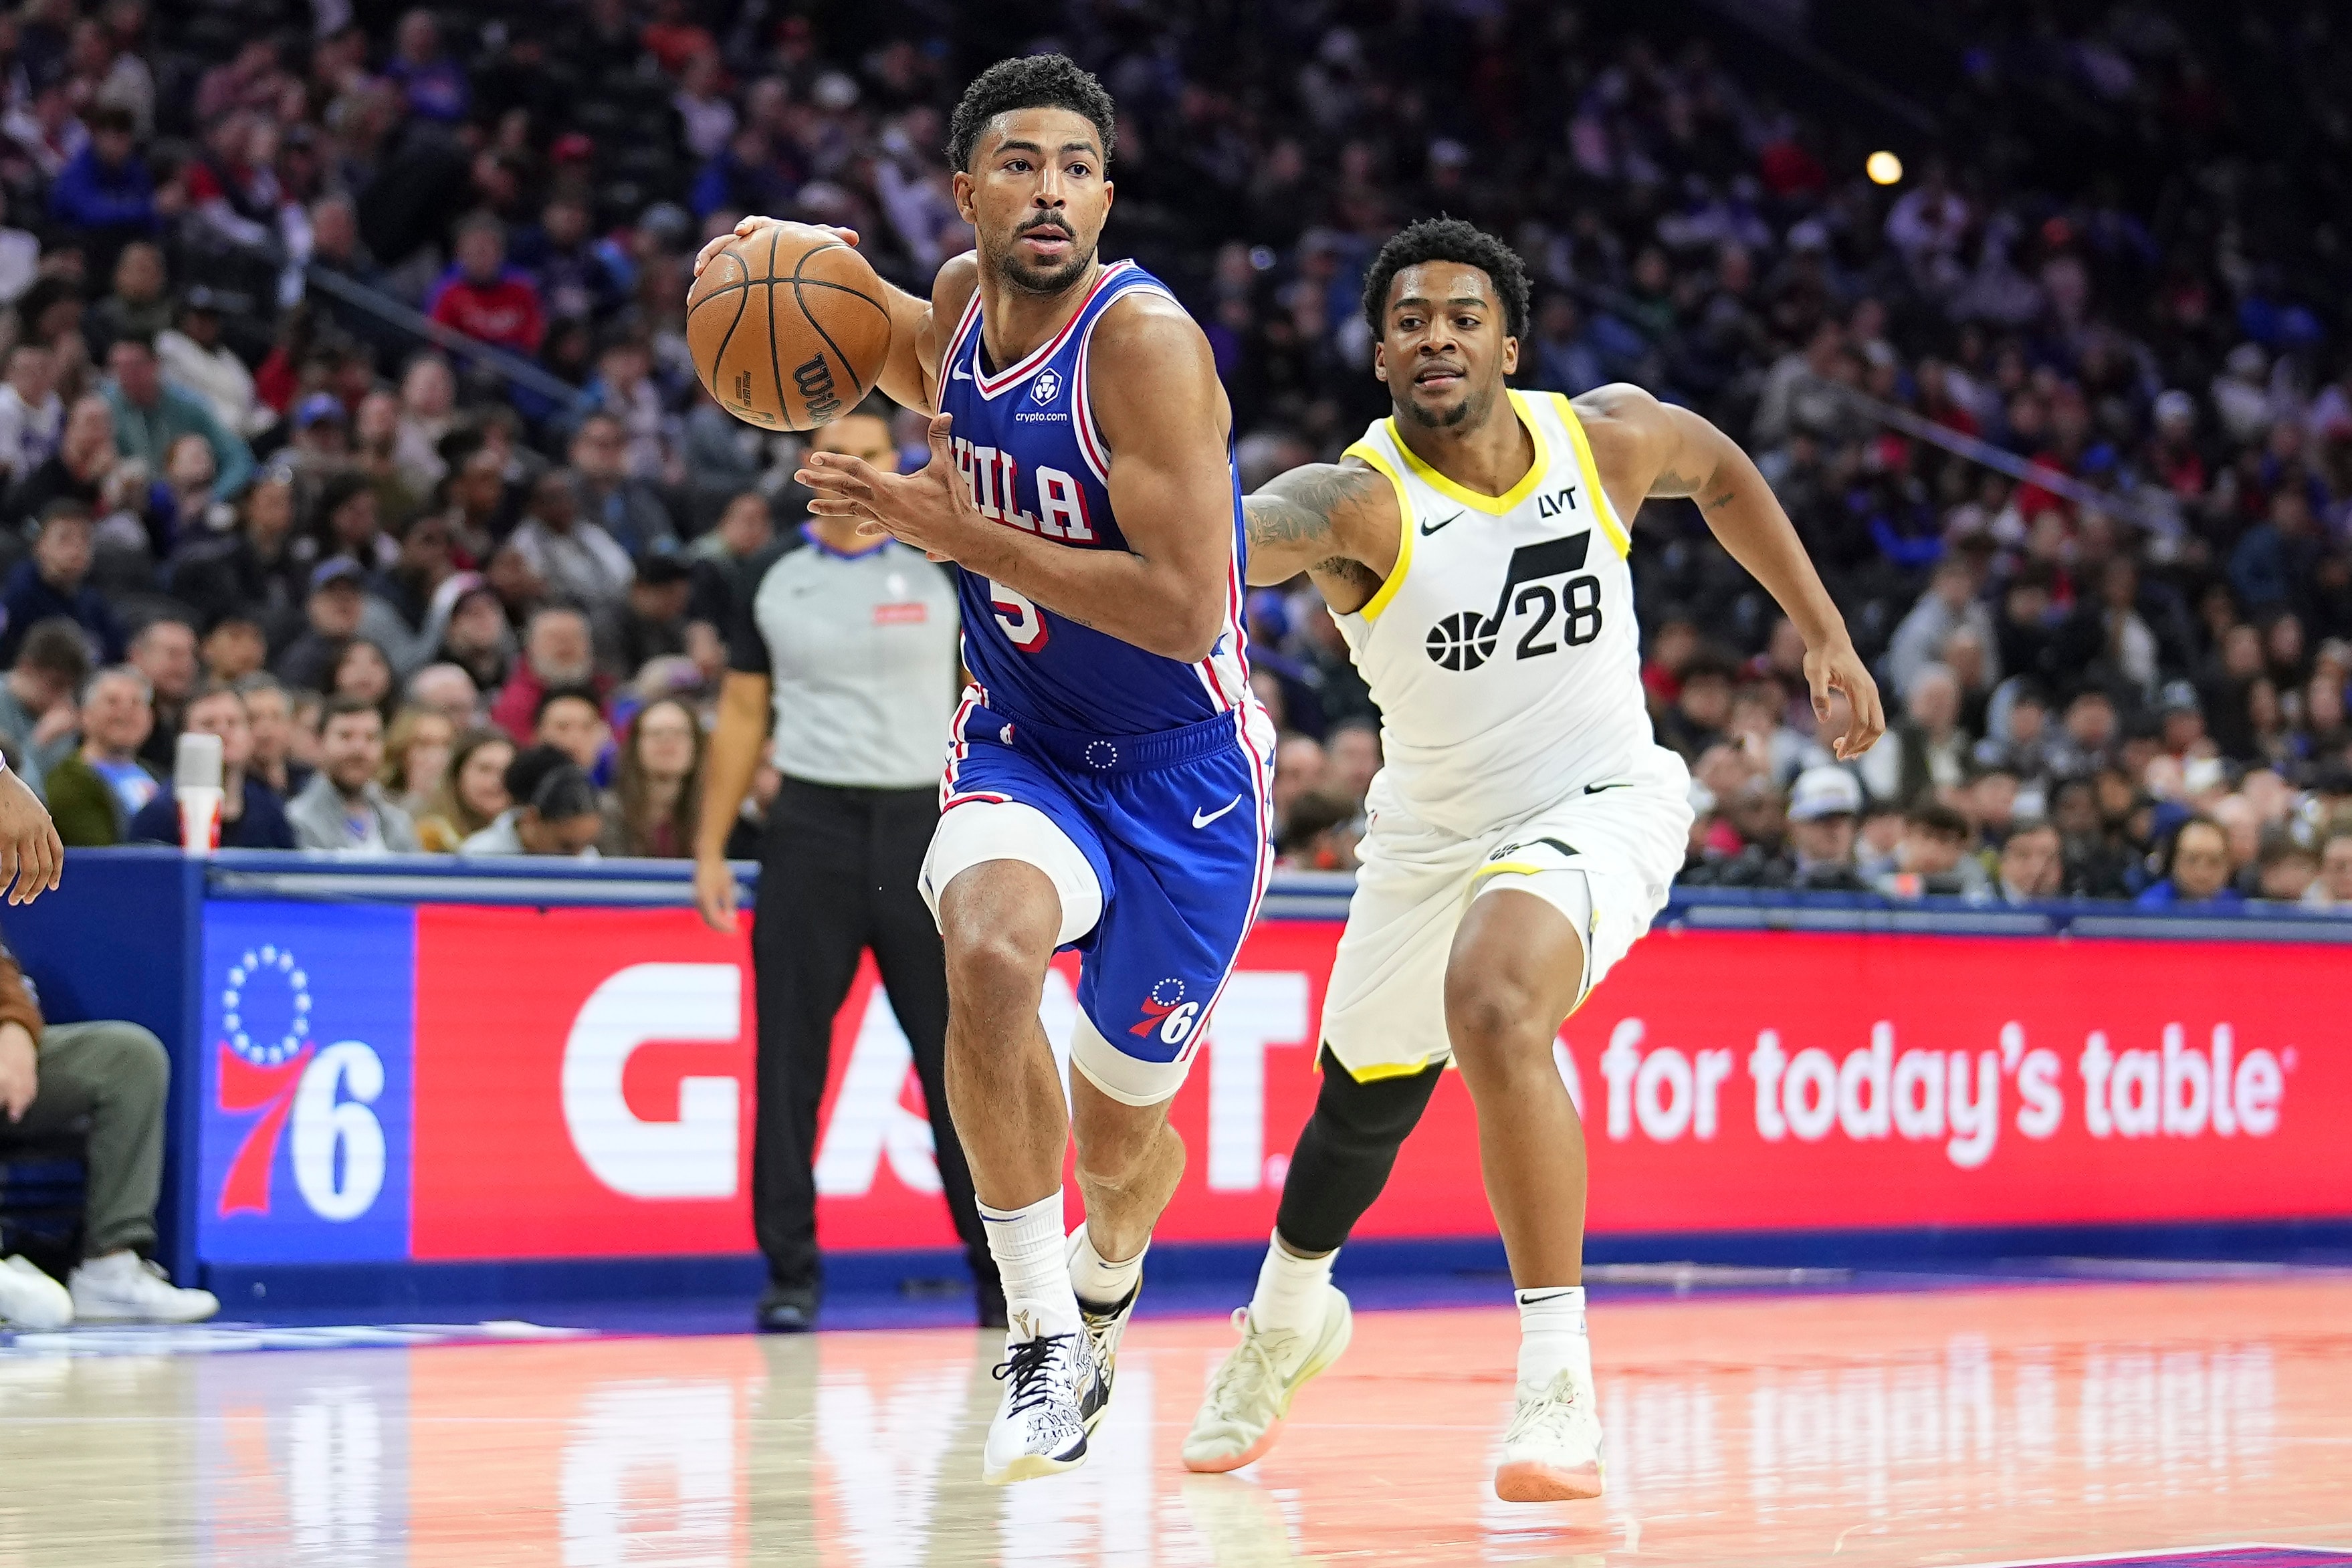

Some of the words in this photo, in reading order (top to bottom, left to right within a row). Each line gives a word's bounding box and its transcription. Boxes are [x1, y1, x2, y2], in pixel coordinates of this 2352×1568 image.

[1015, 412, 1067, 423] crypto.com
[948, 435, 1099, 544] HILA
[1537, 485, 1576, 519] LVT
[989, 578, 1049, 653] 5
[1515, 574, 1602, 661] 28
[1128, 996, 1199, 1044] 76
[217, 1039, 388, 1224] 76
[1600, 1017, 1734, 1141] for
[1748, 1021, 2064, 1169] today's
[2079, 1022, 2284, 1138] table
